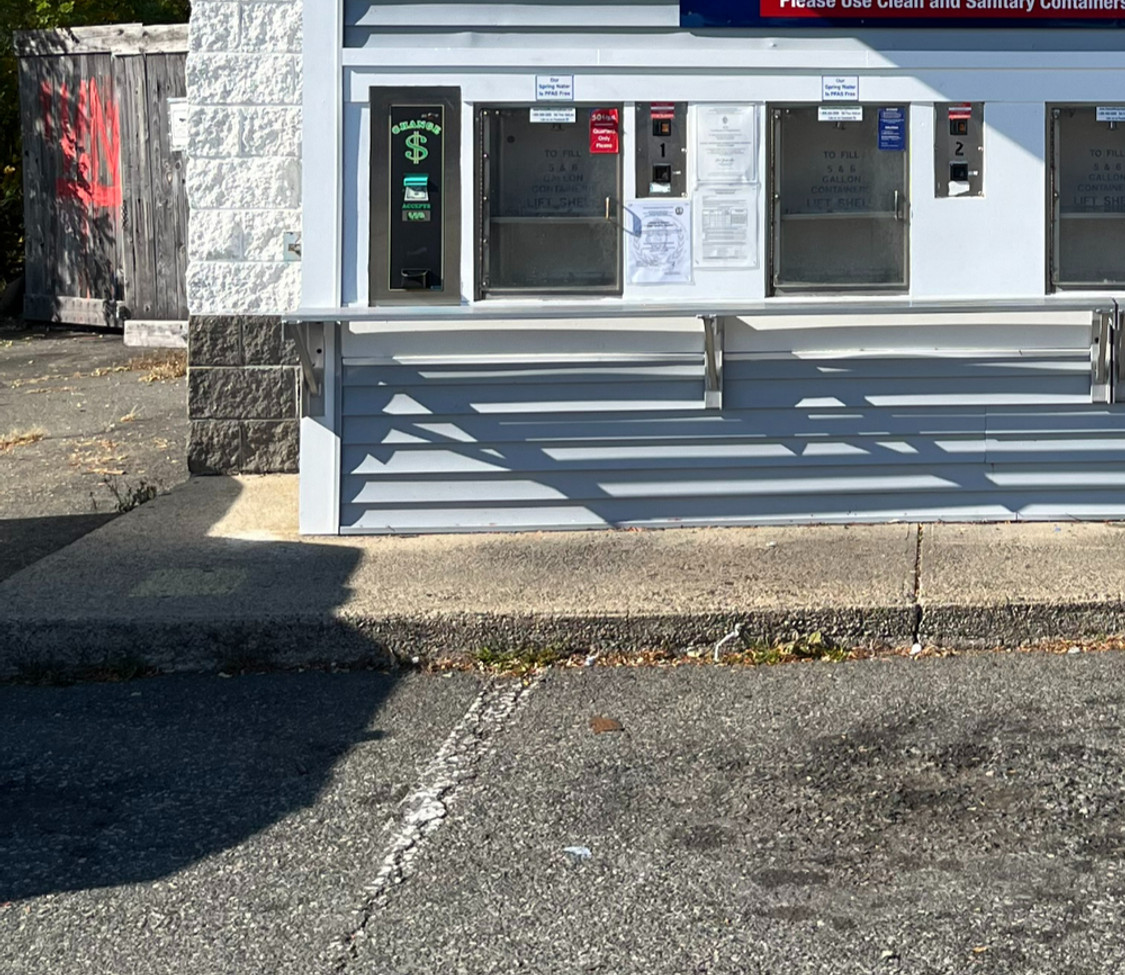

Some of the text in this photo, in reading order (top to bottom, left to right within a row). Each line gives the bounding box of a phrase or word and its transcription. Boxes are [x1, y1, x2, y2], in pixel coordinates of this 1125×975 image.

[660, 142, 666, 158] 1
[955, 141, 965, 157] 2
[1089, 149, 1125, 158] TO FILL
[822, 175, 862, 183] GALLON
[1073, 196, 1098, 206] LIFT
